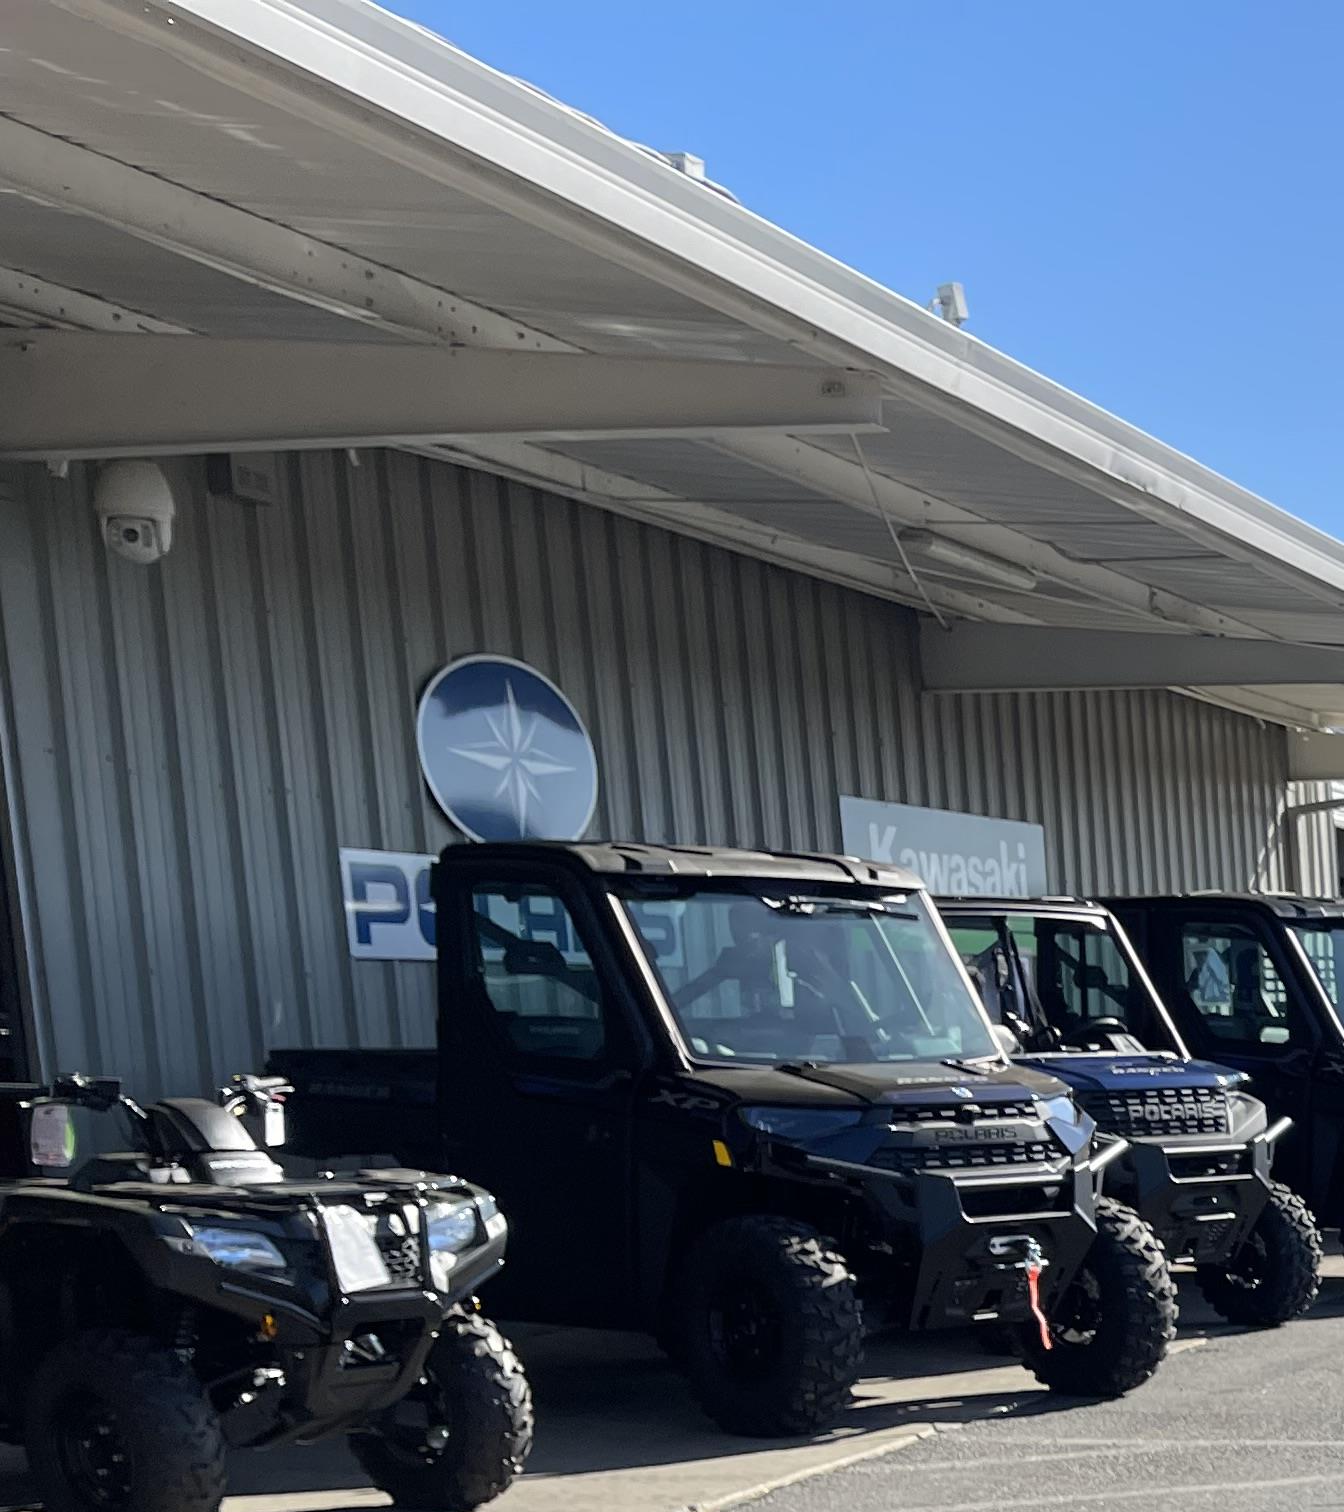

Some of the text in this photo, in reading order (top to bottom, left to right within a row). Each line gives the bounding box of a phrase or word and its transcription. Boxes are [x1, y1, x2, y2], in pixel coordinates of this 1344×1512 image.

[868, 822, 1028, 896] Kawasaki
[1127, 1103, 1215, 1121] POLARIS
[934, 1126, 1018, 1142] POLARIS
